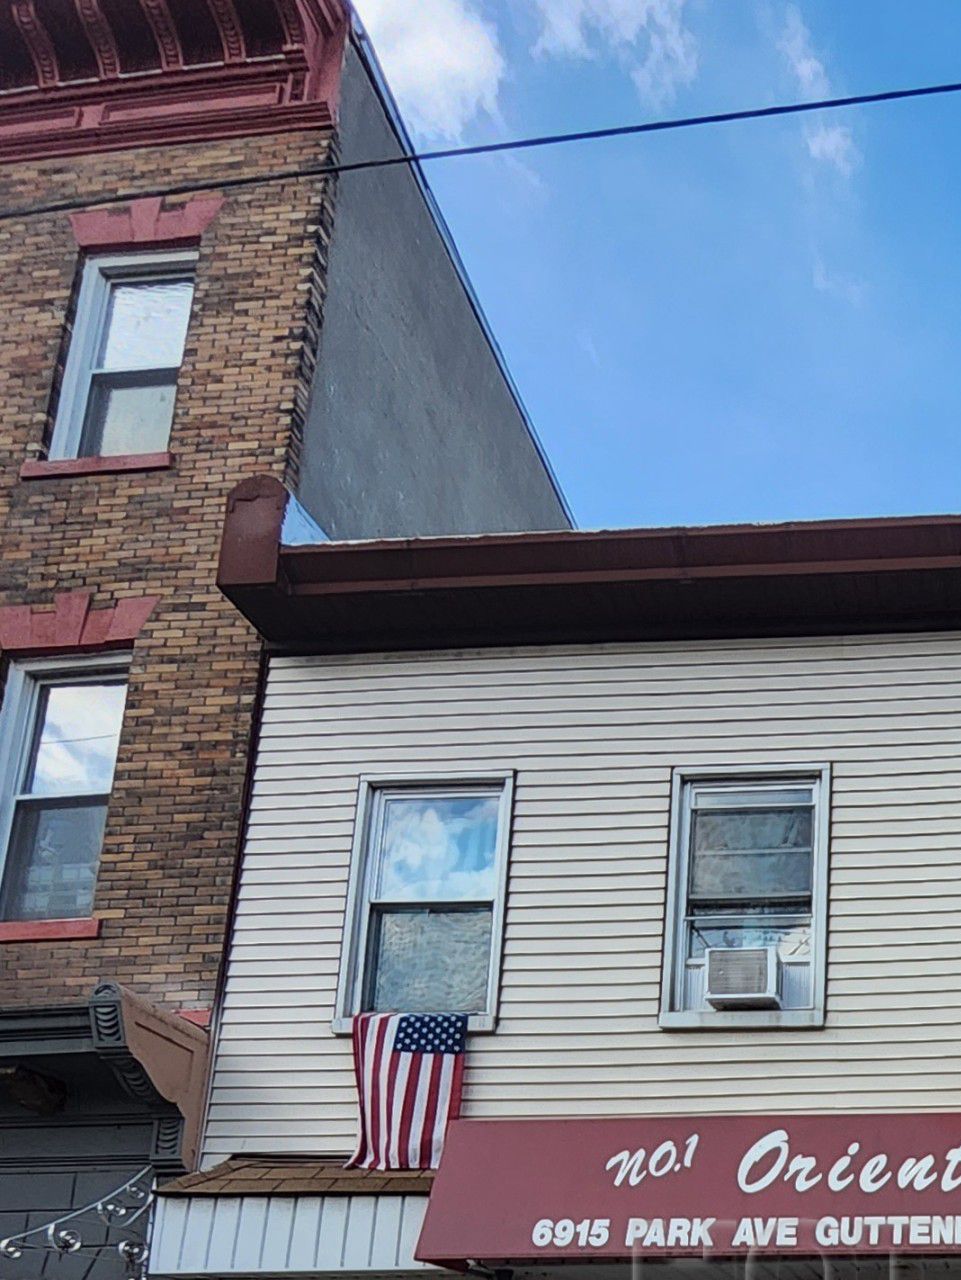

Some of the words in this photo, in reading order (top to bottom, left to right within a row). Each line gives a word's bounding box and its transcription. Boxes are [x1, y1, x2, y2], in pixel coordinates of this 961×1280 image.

[531, 1218, 611, 1248] 6915
[625, 1218, 717, 1247] PARK
[732, 1217, 799, 1247] AVE
